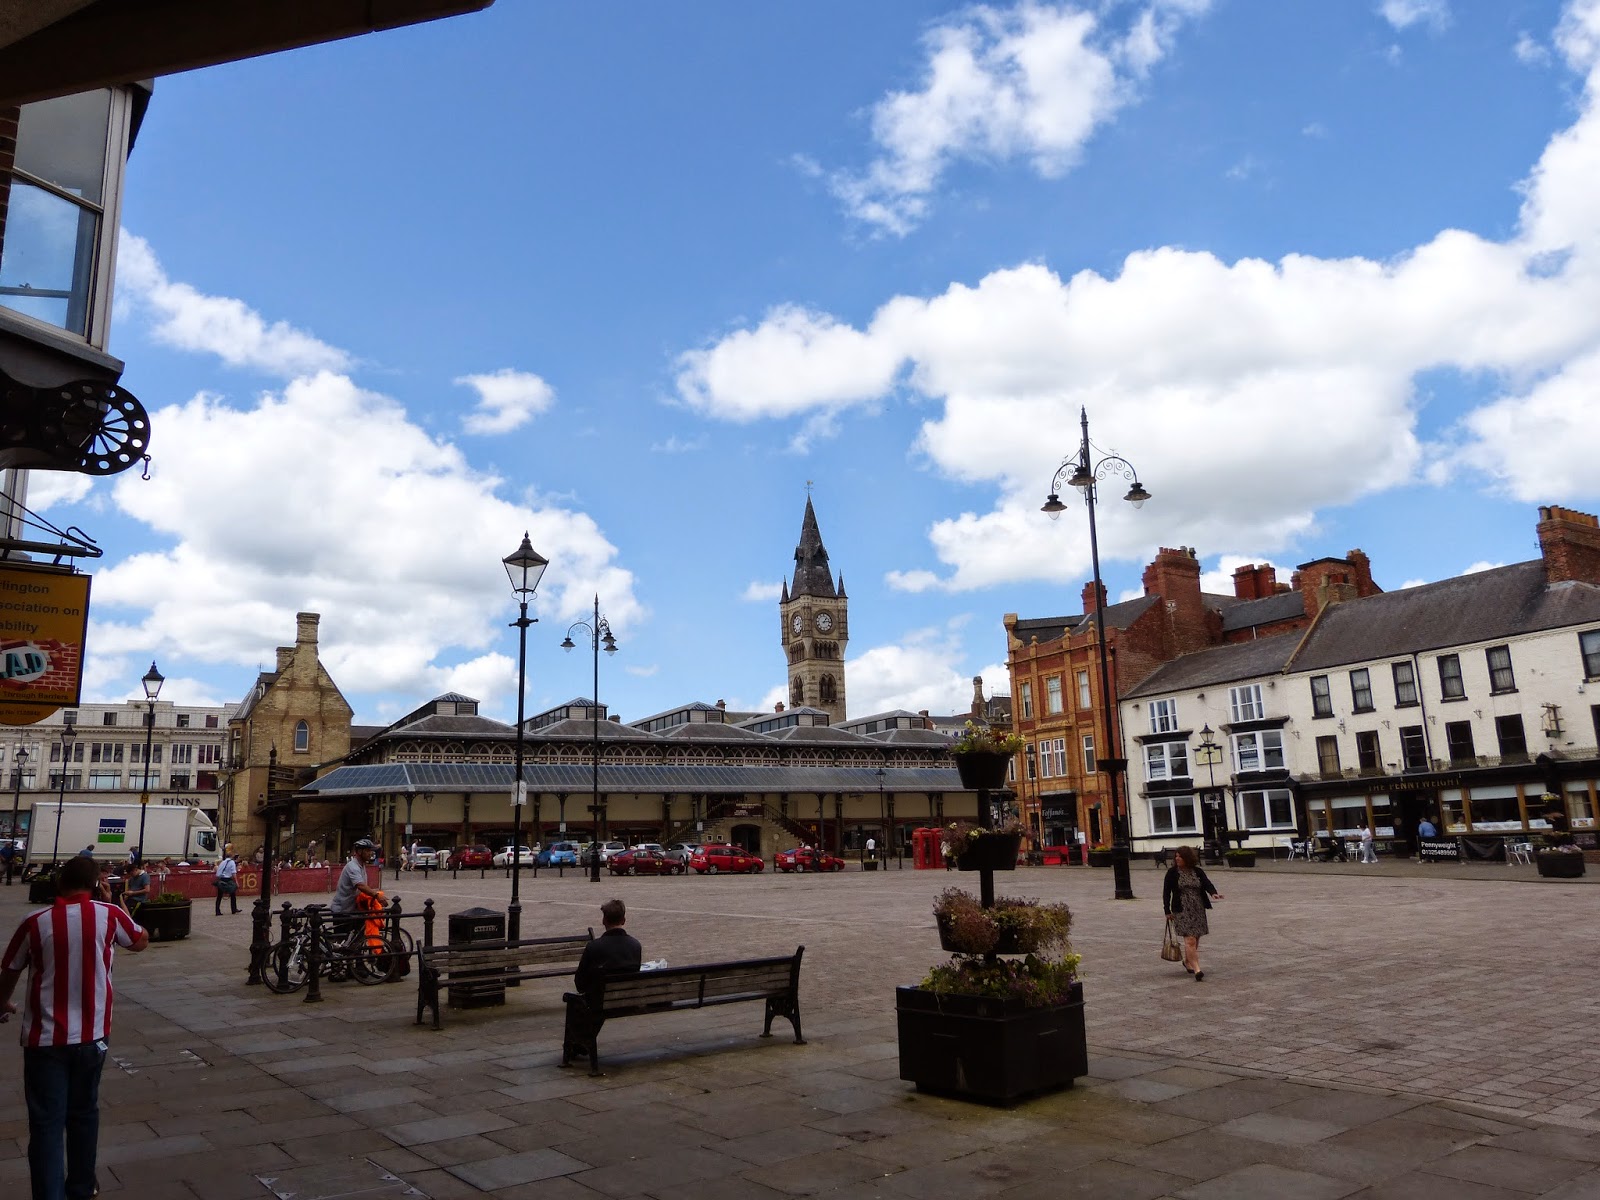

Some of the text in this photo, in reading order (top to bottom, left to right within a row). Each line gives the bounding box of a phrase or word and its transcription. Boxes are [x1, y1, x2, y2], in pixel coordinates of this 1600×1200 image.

[63, 607, 80, 616] on
[162, 798, 201, 807] BINNS
[1421, 842, 1457, 850] Pennyweight
[239, 873, 258, 889] 16
